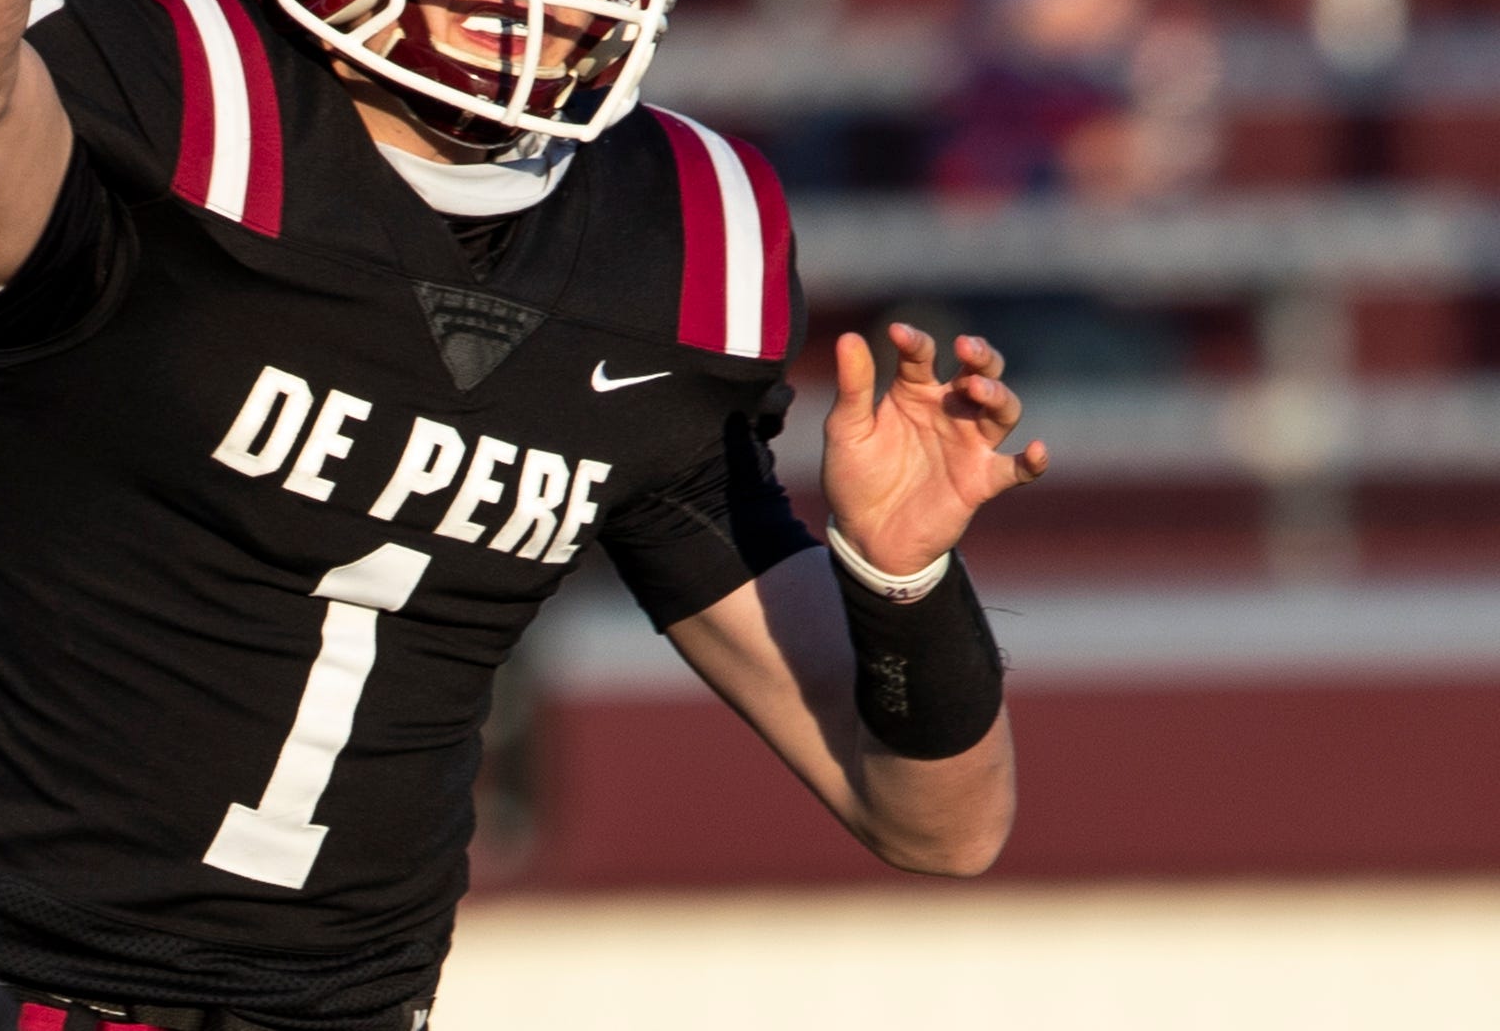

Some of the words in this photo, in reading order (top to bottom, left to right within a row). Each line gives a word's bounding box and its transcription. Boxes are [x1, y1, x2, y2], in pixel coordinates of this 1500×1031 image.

[211, 366, 373, 502] DE
[368, 416, 612, 564] PERE
[202, 542, 432, 889] 1
